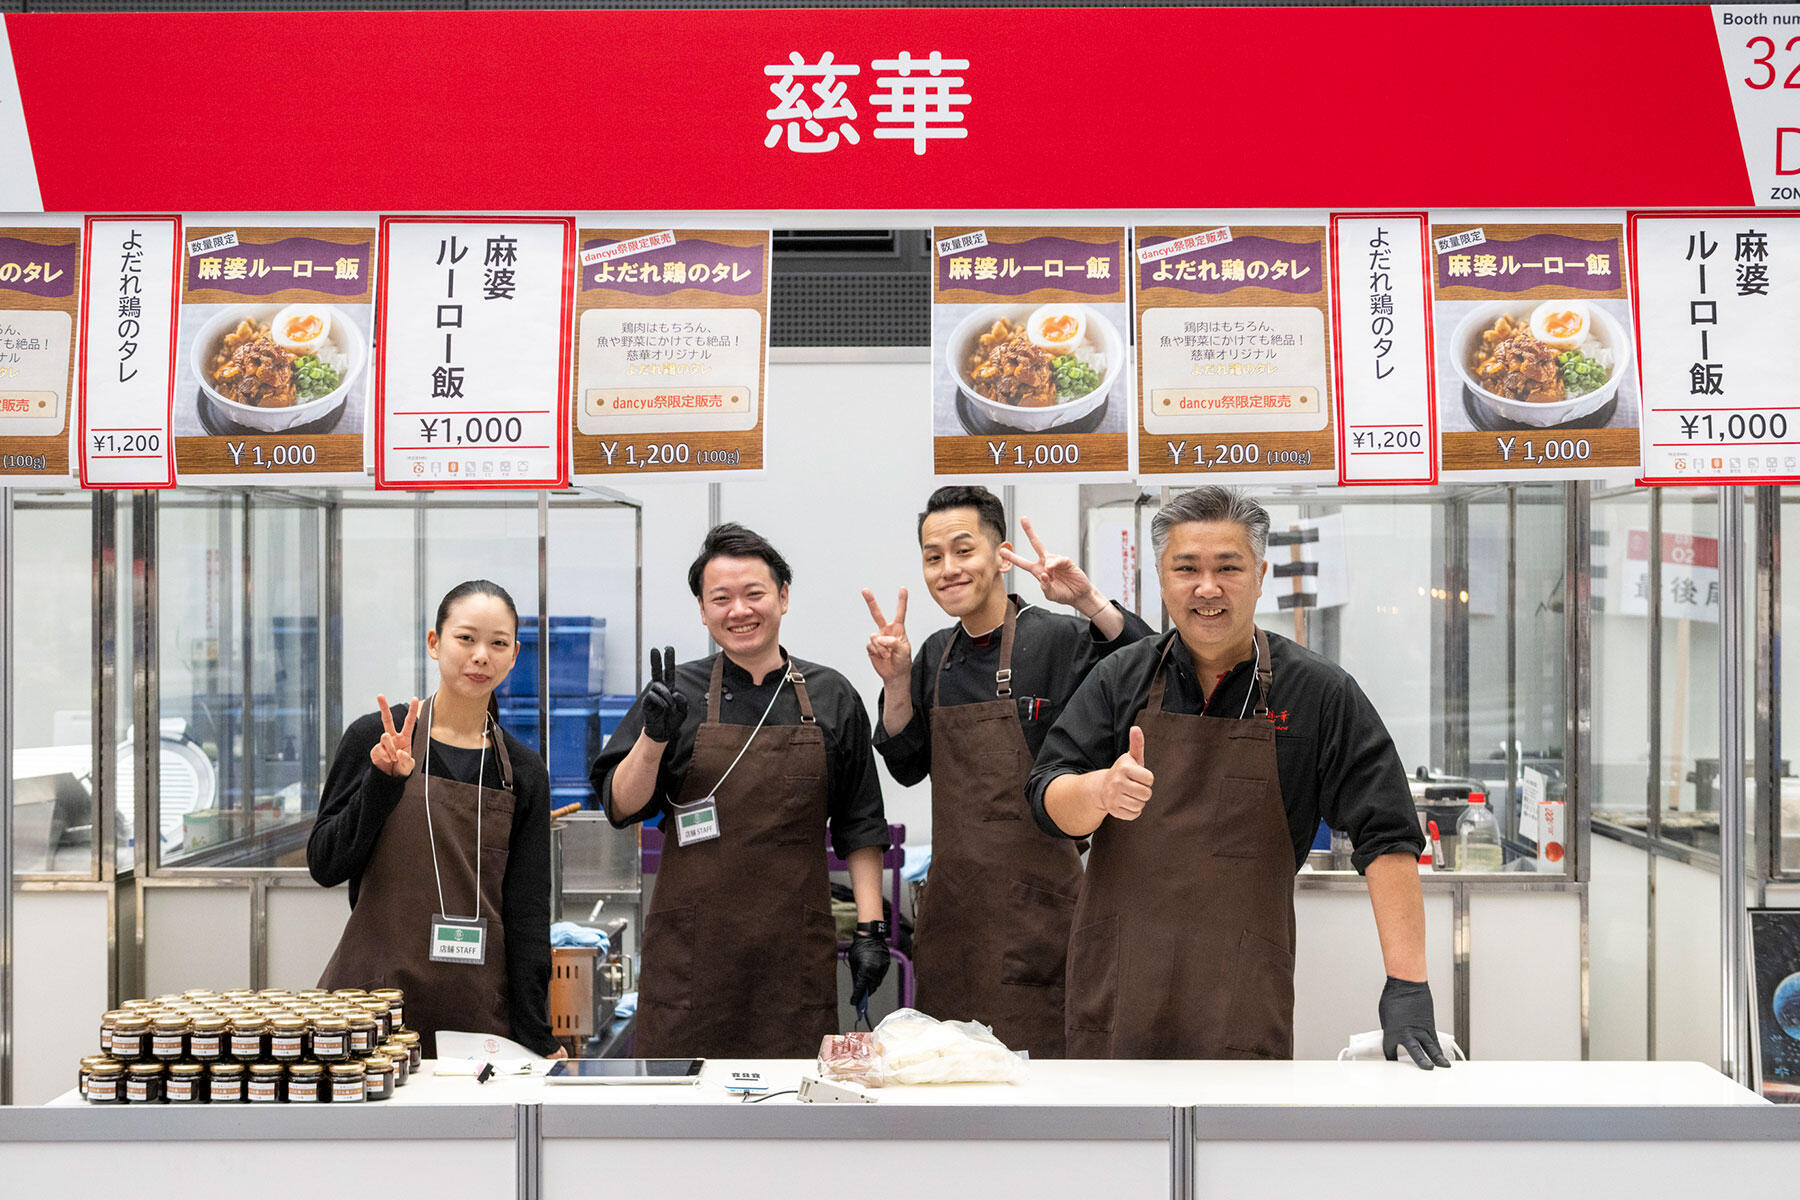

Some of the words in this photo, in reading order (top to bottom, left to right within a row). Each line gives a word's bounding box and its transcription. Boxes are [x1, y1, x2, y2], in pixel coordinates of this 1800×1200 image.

[1723, 12, 1768, 25] Booth
[764, 50, 972, 155] 慈華
[191, 233, 235, 253] 数量限定
[584, 232, 672, 262] dancyu祭限定販売
[940, 233, 985, 252] 数量限定
[1141, 229, 1228, 260] dancyu祭限定販売
[1437, 231, 1483, 252] 数量限定
[198, 257, 360, 281] 麻婆ルーロー飯
[483, 234, 518, 300] 麻婆
[594, 262, 752, 284] よだれ鶏のタレ
[949, 256, 1111, 280] 麻婆ルーロー飯
[1152, 258, 1311, 281] よだれ鶏のタレ
[1447, 253, 1612, 278] 麻婆ルーロー飯
[1734, 229, 1770, 297] 麻婆
[118, 229, 143, 383] よだれ鶏のタレ
[1368, 226, 1395, 381] よだれ鶏のタレ
[1685, 230, 1724, 396] ルーロー飯
[431, 235, 469, 399] ルーロー飯
[621, 321, 712, 334] 鶏肉はもちろん、
[1183, 321, 1275, 334] 鶏肉はもちろん、
[597, 335, 740, 348] 魚や野菜にかけても絶品！
[1160, 334, 1304, 347] 魚や野菜にかけても絶品！
[626, 349, 712, 361] 慈華オリジナル
[1190, 348, 1278, 361] 慈華オリジナル
[0, 399, 30, 412] 販売
[612, 394, 723, 411] dancyu祭限定販売
[1179, 394, 1292, 411] dancyu祭限定販売
[420, 416, 523, 446] ¥1,000
[1679, 412, 1788, 442] ¥1,000
[93, 434, 161, 453] ¥1,200
[1352, 430, 1421, 450] ¥1,200
[2, 453, 47, 471] (100g)
[695, 448, 741, 465] (100g)
[1266, 448, 1312, 465] (100g)
[455, 945, 477, 955] STAFF
